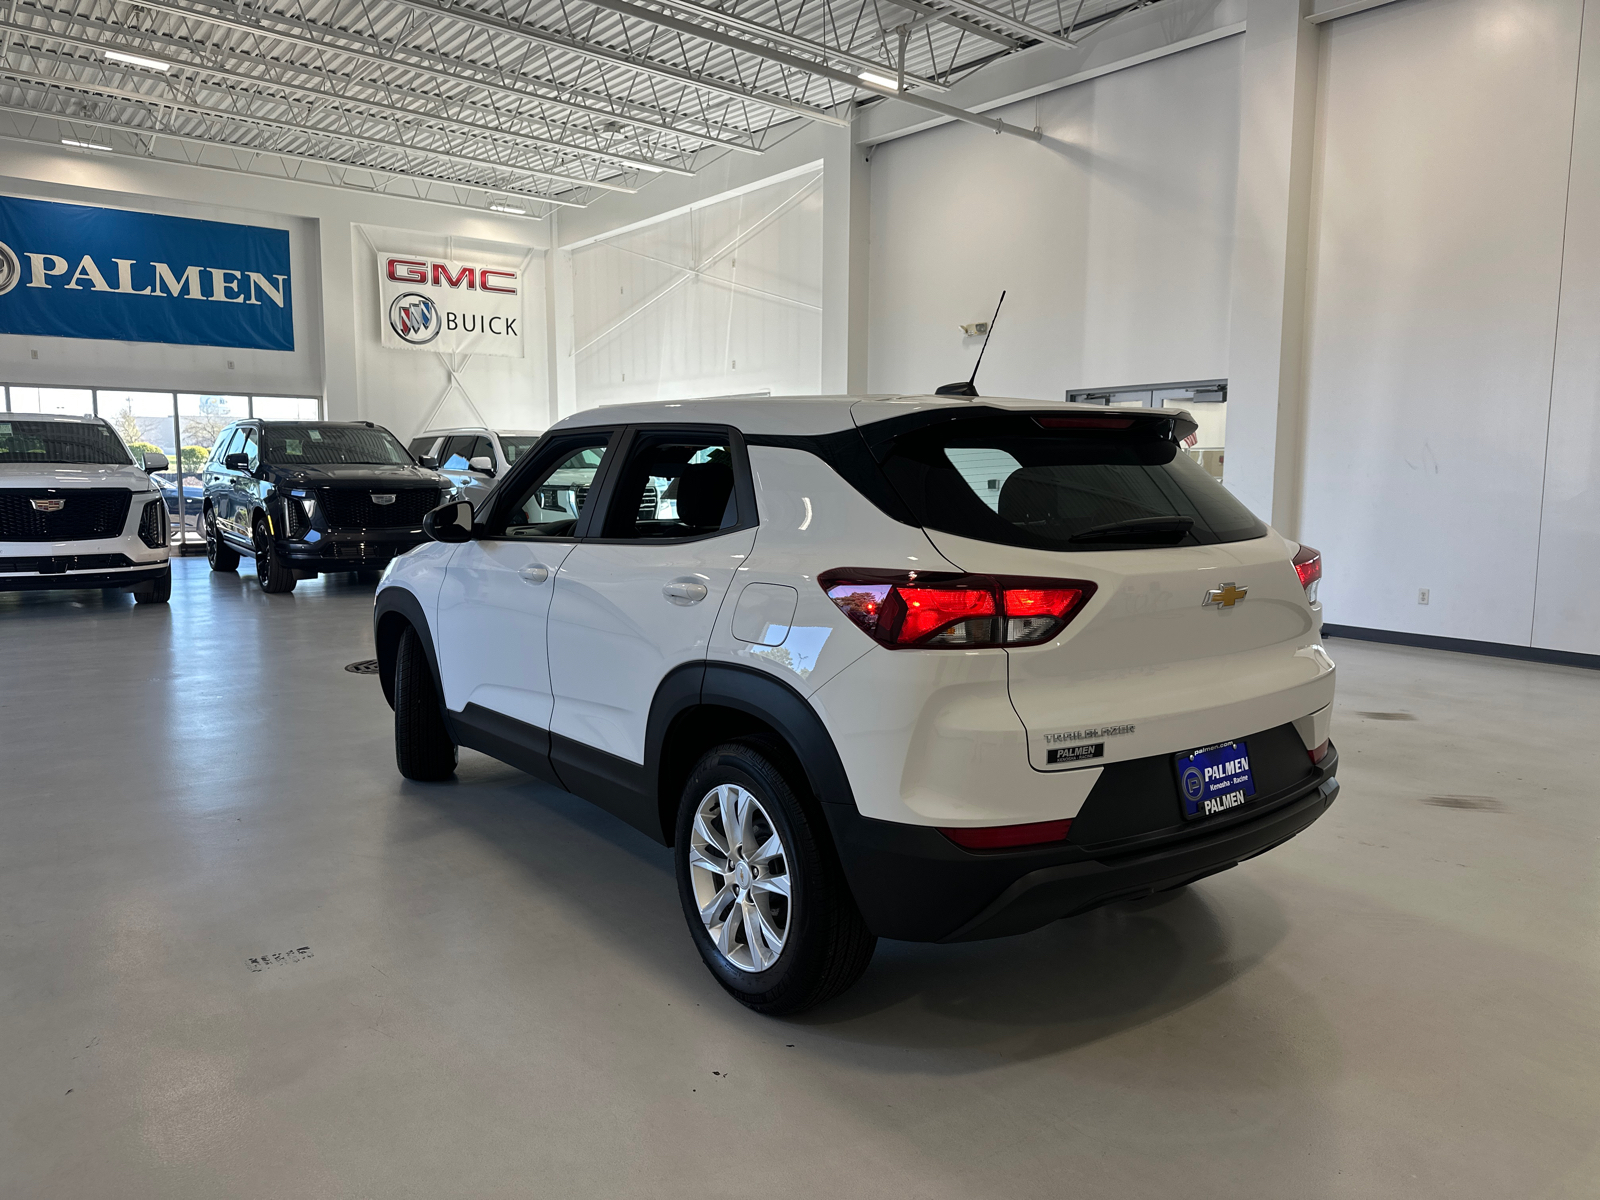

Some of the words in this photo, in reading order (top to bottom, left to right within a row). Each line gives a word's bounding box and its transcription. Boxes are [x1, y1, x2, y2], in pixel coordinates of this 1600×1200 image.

[24, 252, 288, 308] PALMEN
[386, 257, 518, 295] GMC
[446, 312, 518, 336] BUICK
[1043, 724, 1136, 743] TRAILBLAZER
[1057, 745, 1096, 758] PALMEN
[1194, 741, 1234, 756] palmen.com
[1204, 756, 1249, 782] PALMEN
[1209, 780, 1231, 791] Kenosha
[1232, 775, 1249, 785] Racine
[1204, 789, 1245, 815] PALMEN
